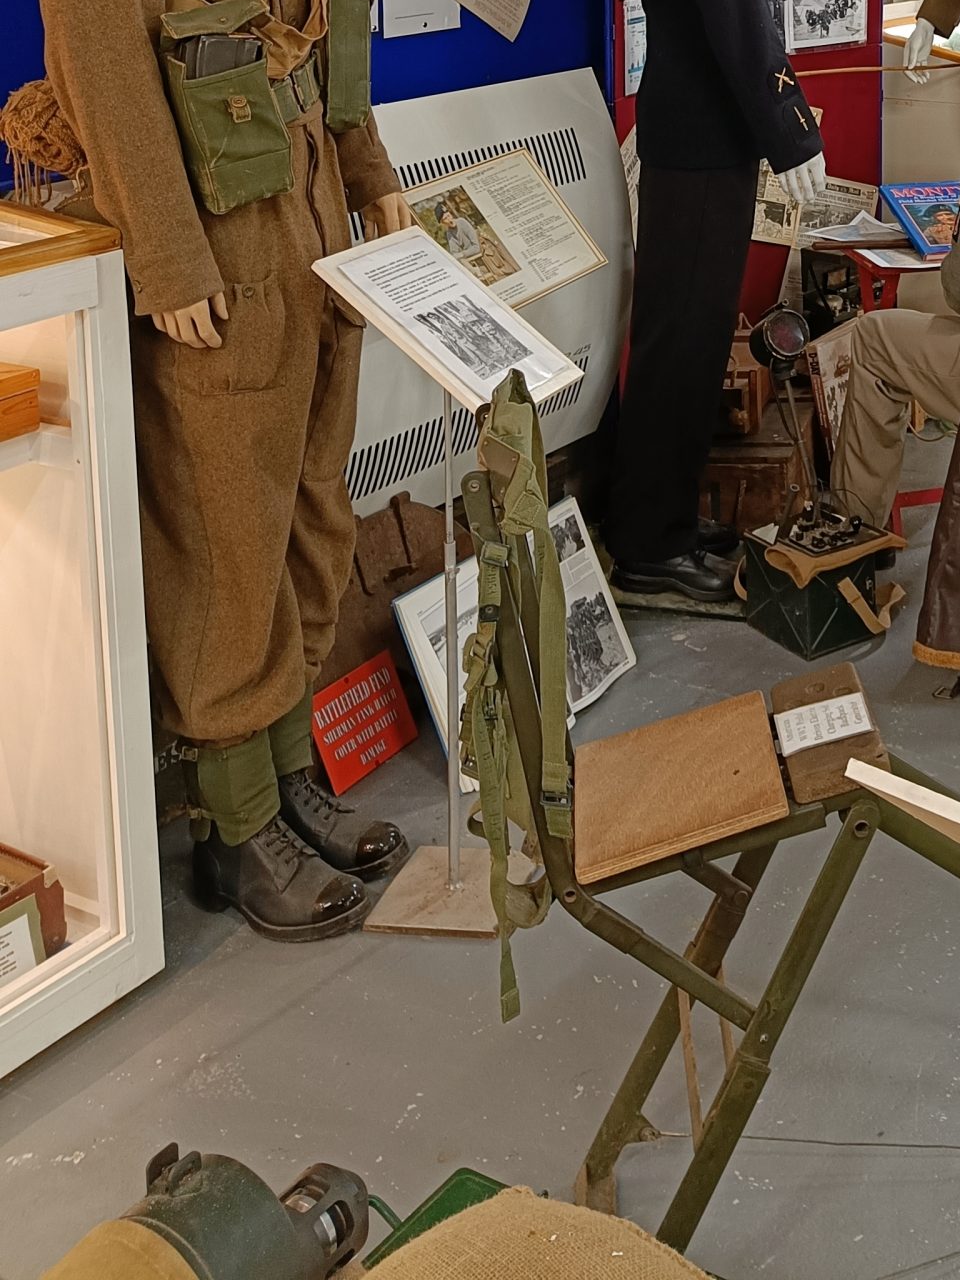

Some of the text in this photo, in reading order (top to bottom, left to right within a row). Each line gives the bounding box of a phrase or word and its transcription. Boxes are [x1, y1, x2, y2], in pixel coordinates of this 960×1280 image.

[313, 667, 391, 730] BATTLEFIELD FIND
[323, 716, 356, 745] SHERMAN
[356, 704, 375, 724] TANK
[334, 709, 398, 761] COVER WITH BATTLE
[360, 739, 387, 765] DAMAGE
